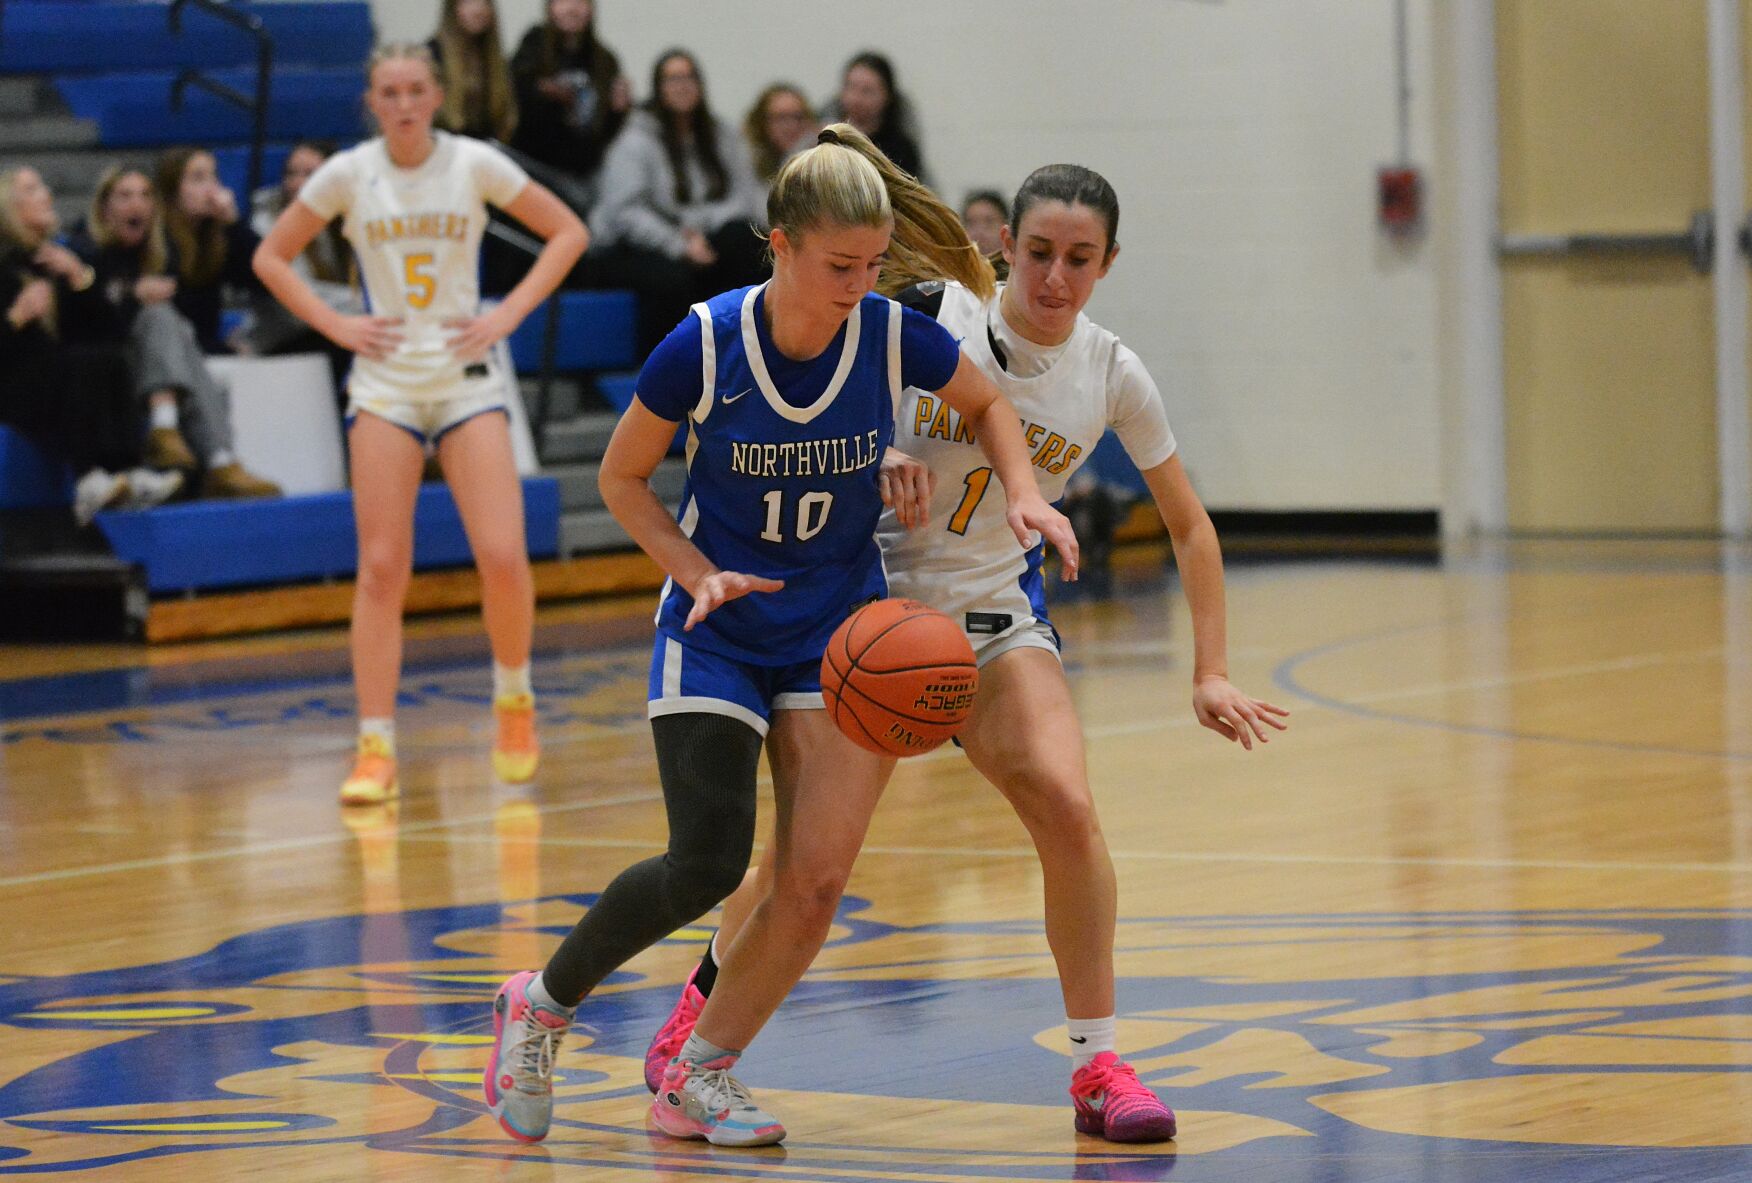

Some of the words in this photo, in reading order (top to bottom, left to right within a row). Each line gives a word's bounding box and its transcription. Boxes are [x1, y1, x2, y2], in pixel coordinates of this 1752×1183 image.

[404, 252, 436, 310] 5
[731, 428, 878, 477] NORTHVILLE
[760, 490, 834, 543] 10
[947, 466, 993, 536] 1
